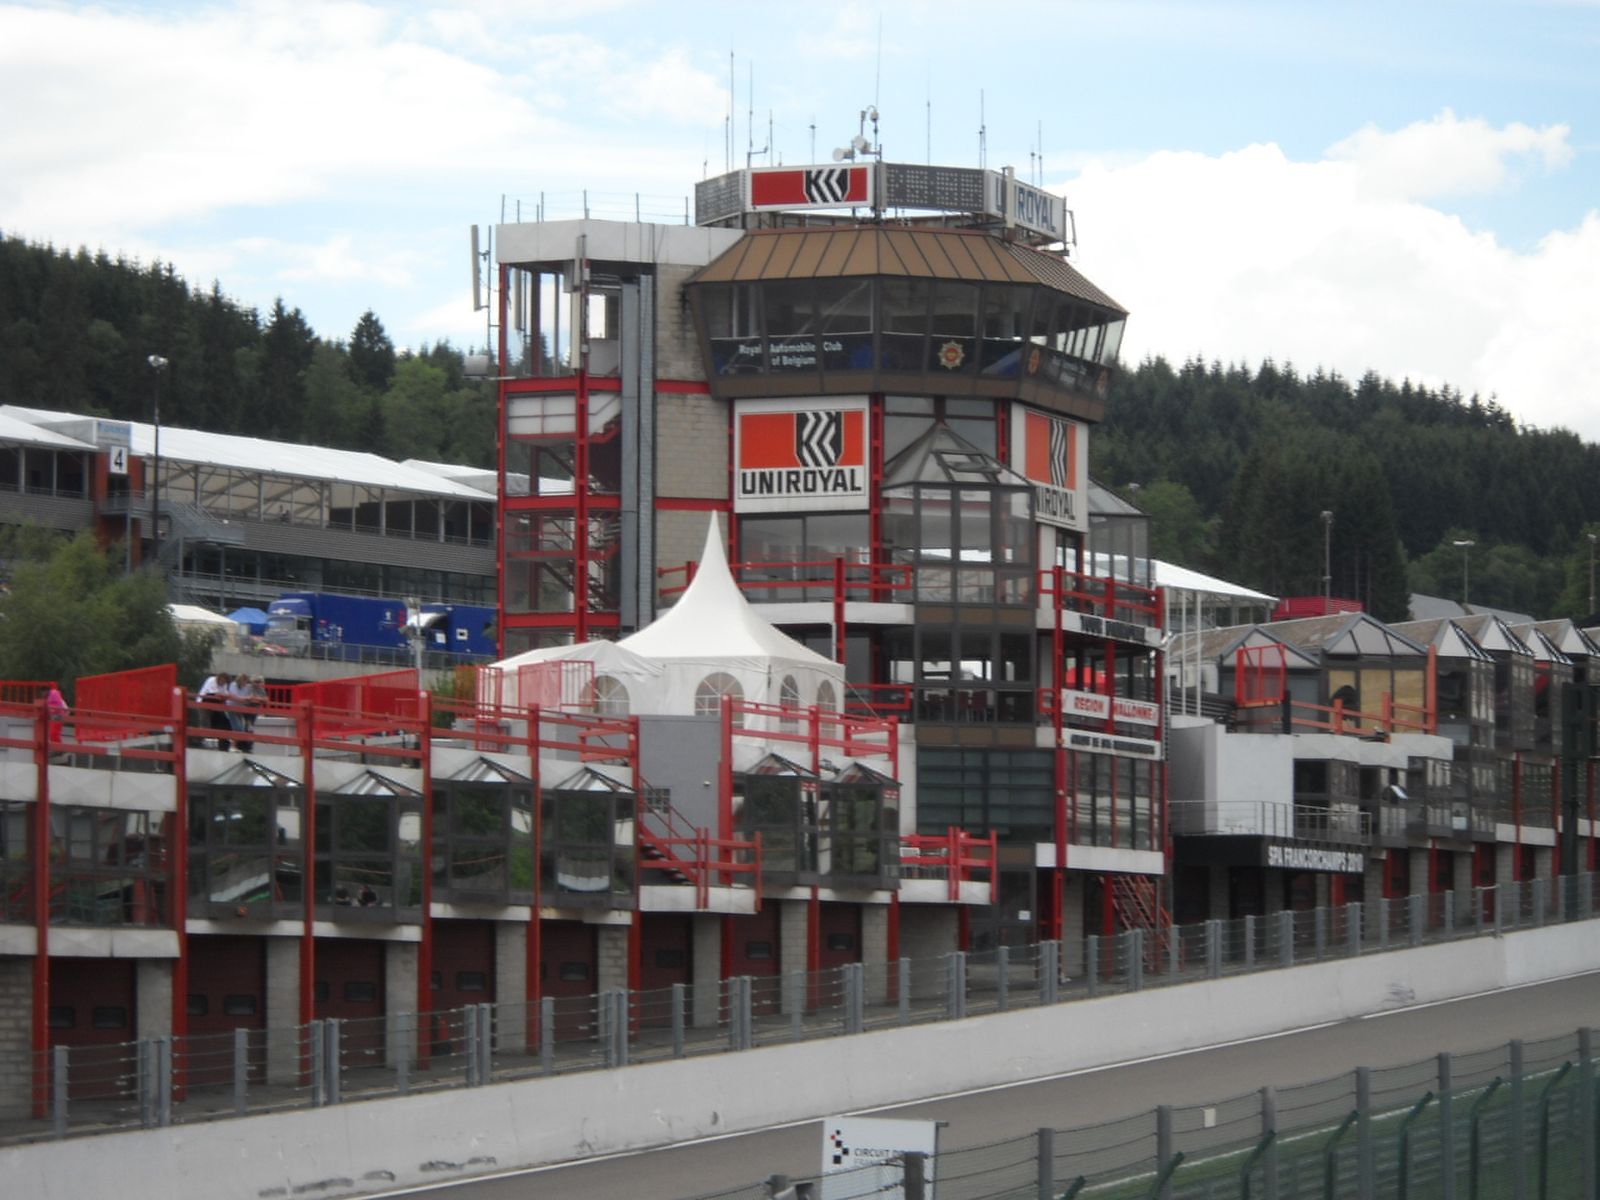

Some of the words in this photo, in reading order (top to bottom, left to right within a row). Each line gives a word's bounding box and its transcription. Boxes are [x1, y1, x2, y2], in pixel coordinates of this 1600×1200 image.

[739, 344, 762, 356] Royal
[770, 342, 816, 353] Automobile
[823, 341, 842, 351] Club
[772, 356, 780, 366] of
[782, 355, 816, 367] Belgium
[114, 449, 123, 471] 4
[742, 468, 862, 495] UNIROYAL
[855, 1148, 889, 1157] CIRCUIT
